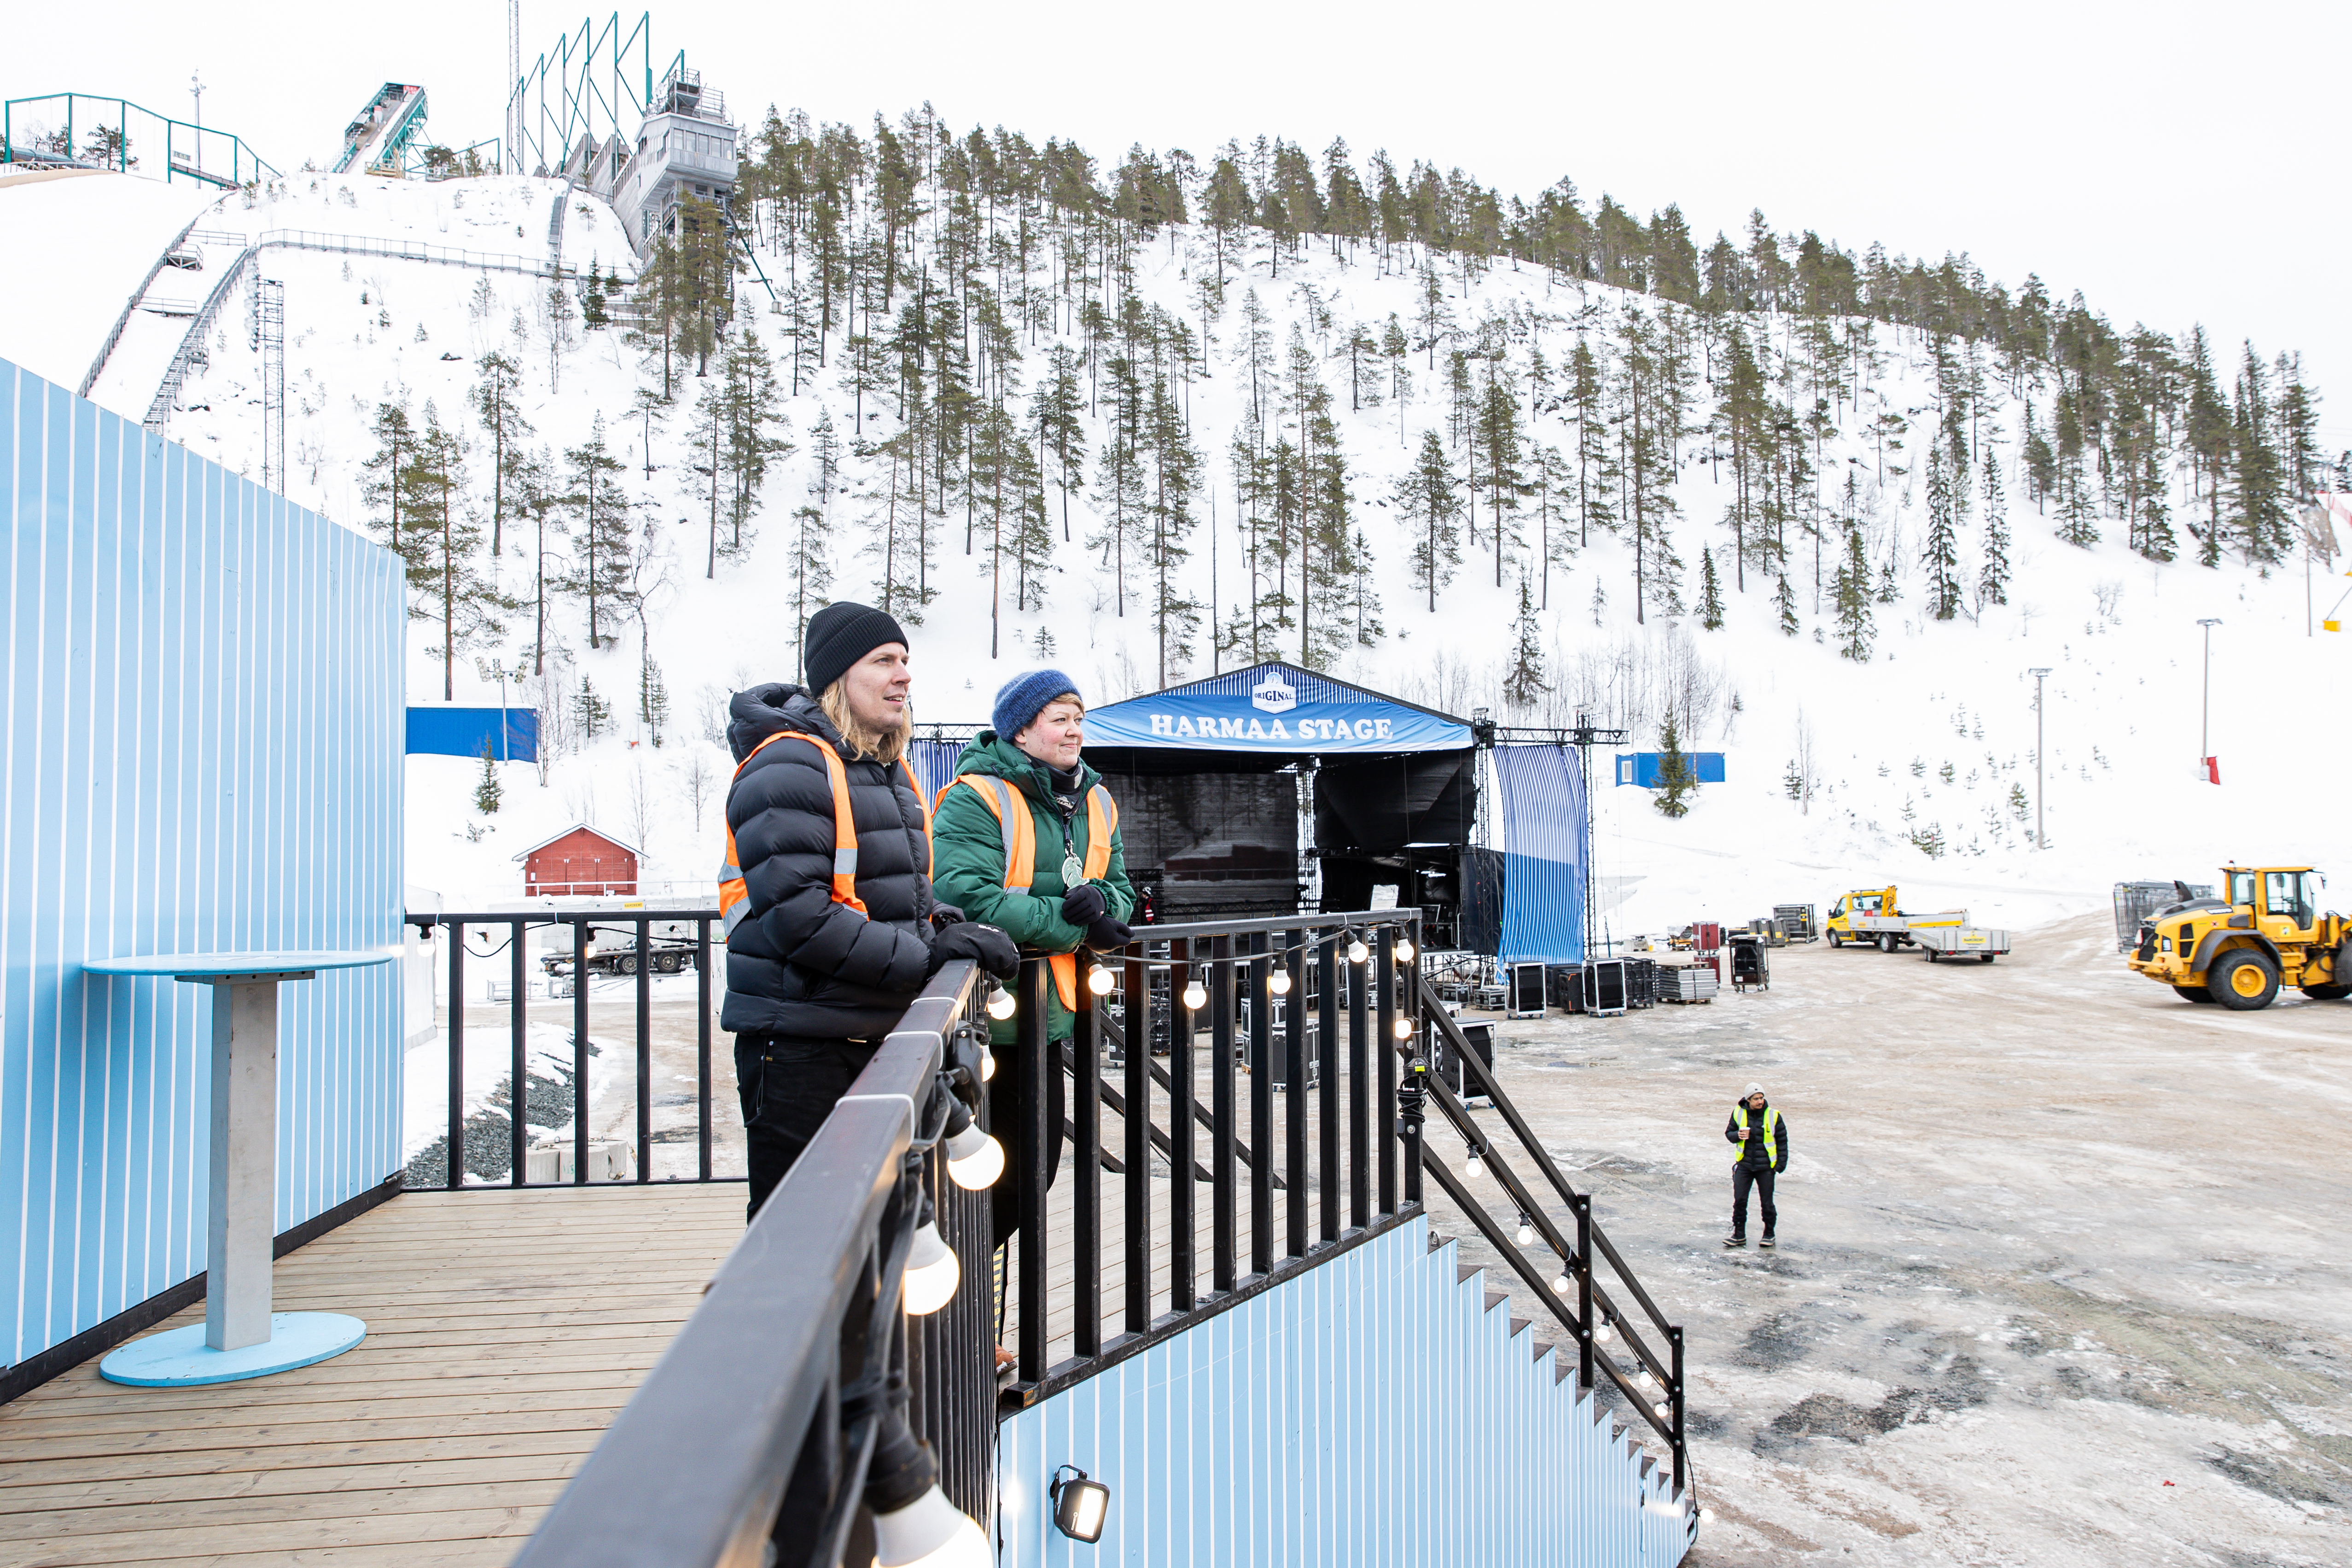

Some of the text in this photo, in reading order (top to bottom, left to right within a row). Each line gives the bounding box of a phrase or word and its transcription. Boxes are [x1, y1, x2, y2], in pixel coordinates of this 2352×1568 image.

[1254, 691, 1294, 701] ORIGINAL
[1149, 714, 1393, 740] HARMAA STAGE
